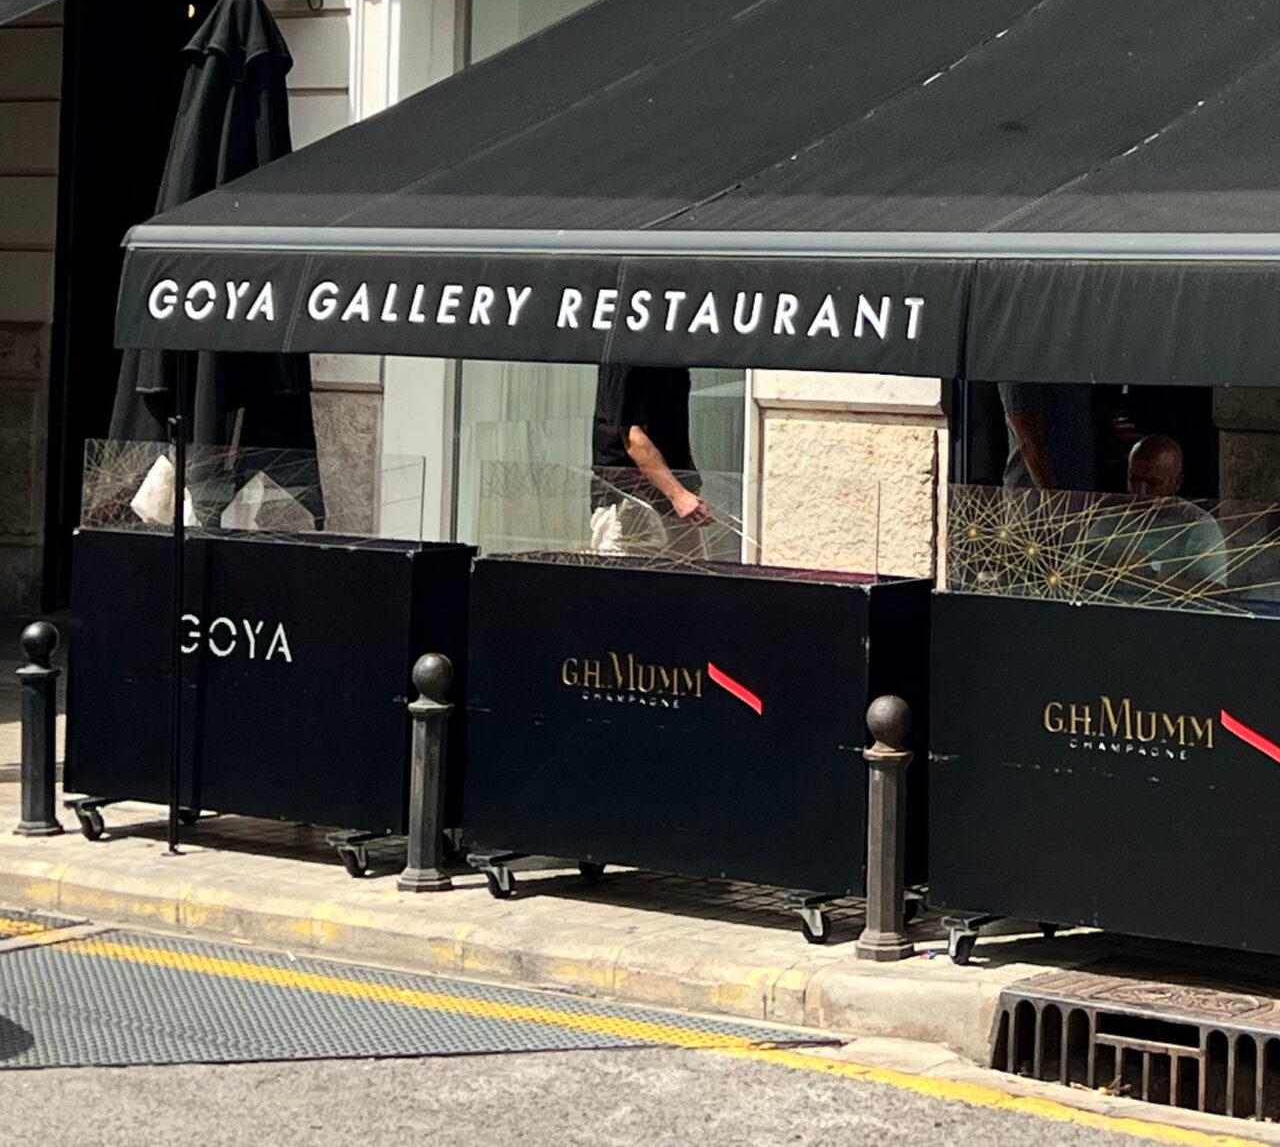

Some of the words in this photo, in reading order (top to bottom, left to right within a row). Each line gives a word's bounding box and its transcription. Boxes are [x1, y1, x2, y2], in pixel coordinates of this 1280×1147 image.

[148, 279, 275, 321] GOYA
[308, 281, 532, 326] GALLERY
[556, 287, 925, 339] RESTAURANT
[181, 614, 292, 662] GOYA
[1069, 738, 1188, 761] CHAMPAGNE
